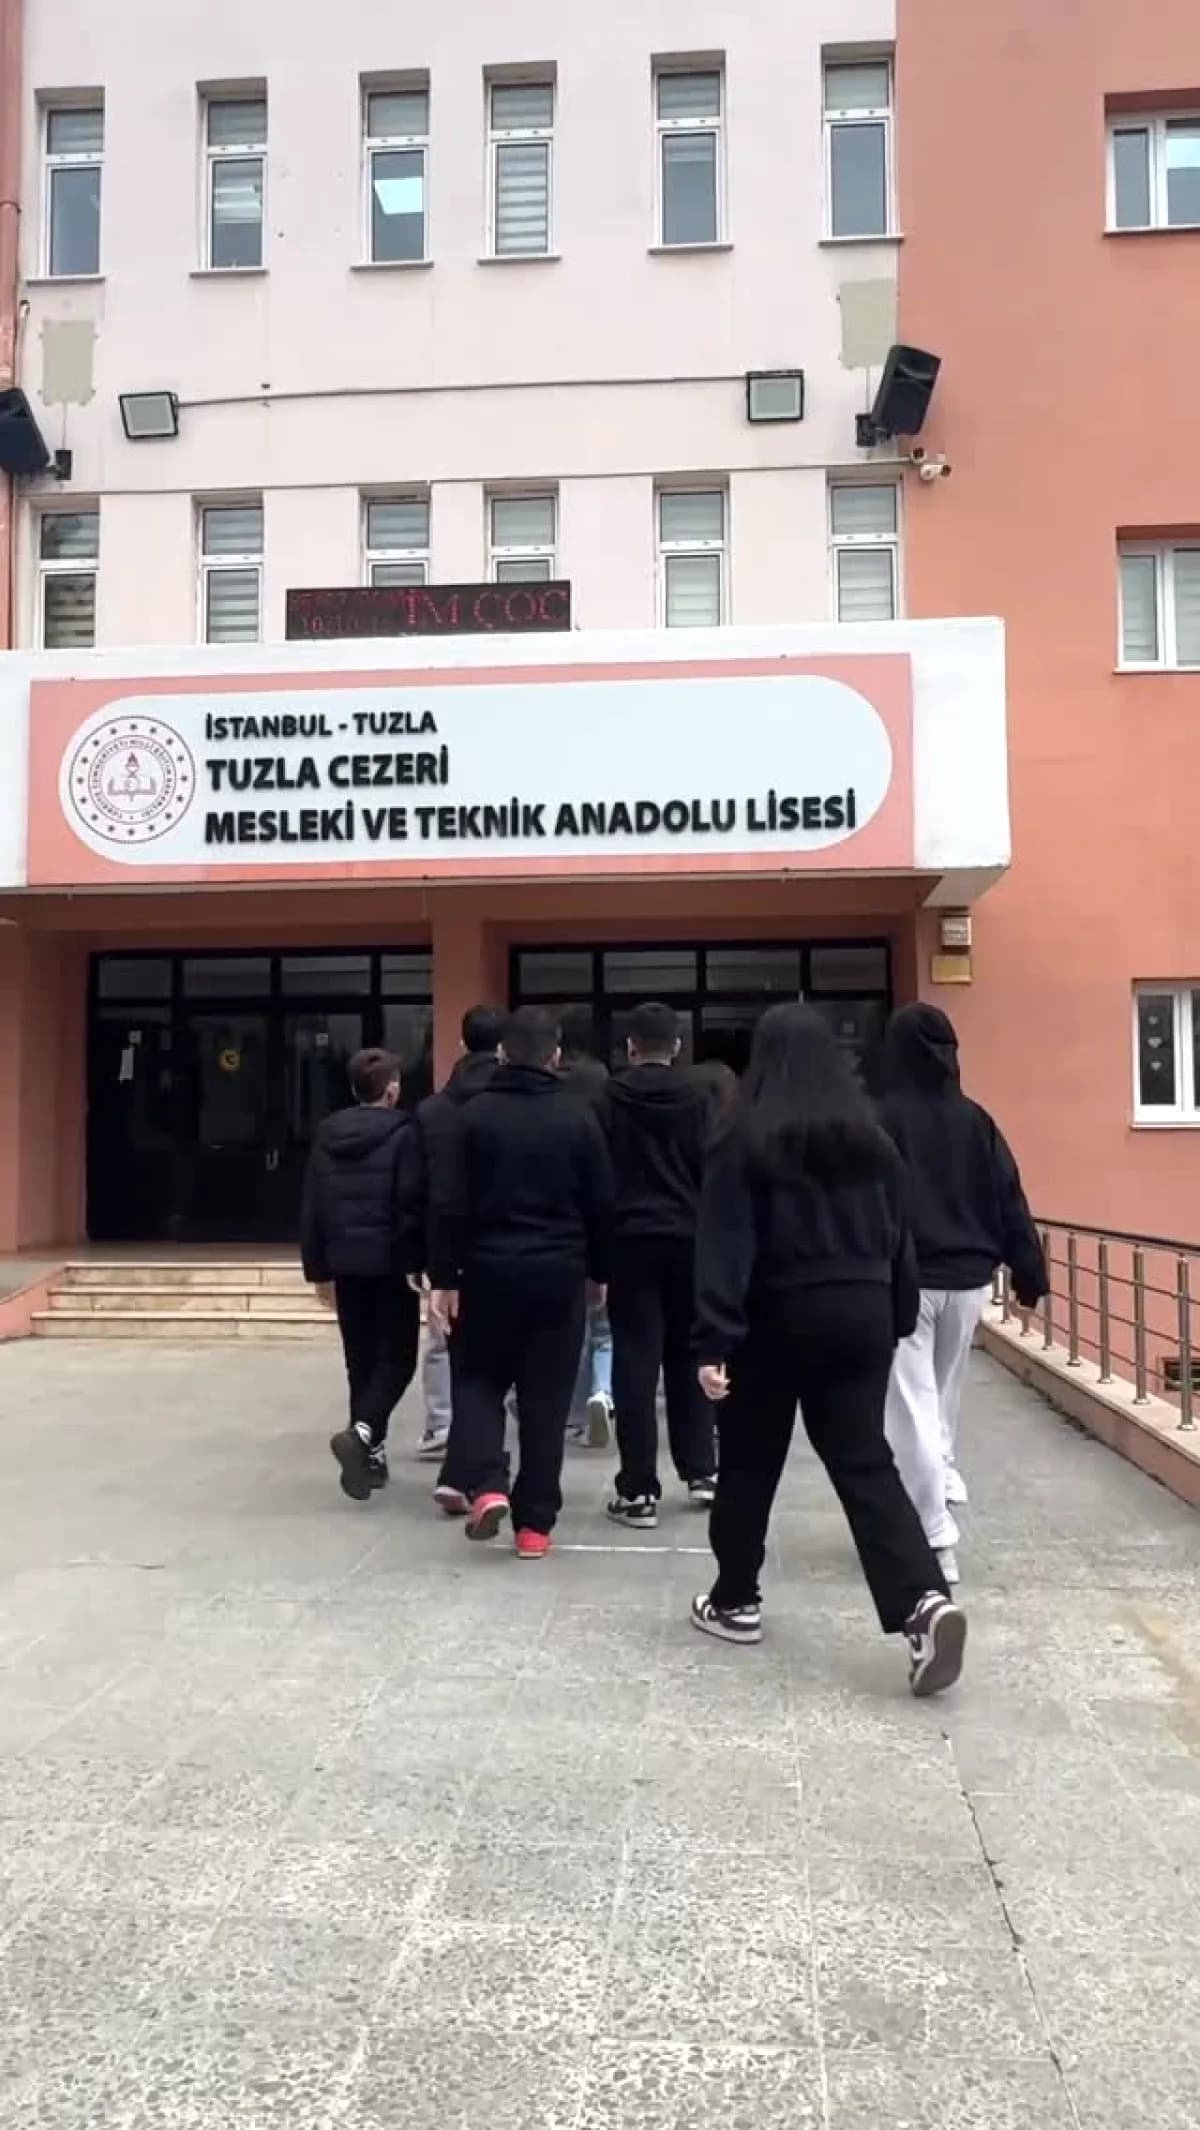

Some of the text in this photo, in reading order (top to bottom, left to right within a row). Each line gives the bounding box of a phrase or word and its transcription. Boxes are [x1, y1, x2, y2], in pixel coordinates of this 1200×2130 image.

[205, 712, 333, 741] İSTANBUL
[352, 710, 438, 736] TUZLA
[205, 756, 321, 792] TUZLA
[327, 744, 449, 789] CEZERİ
[204, 787, 856, 845] MESLEKİ VE TEKNİK ANADOLU LİSESİ
